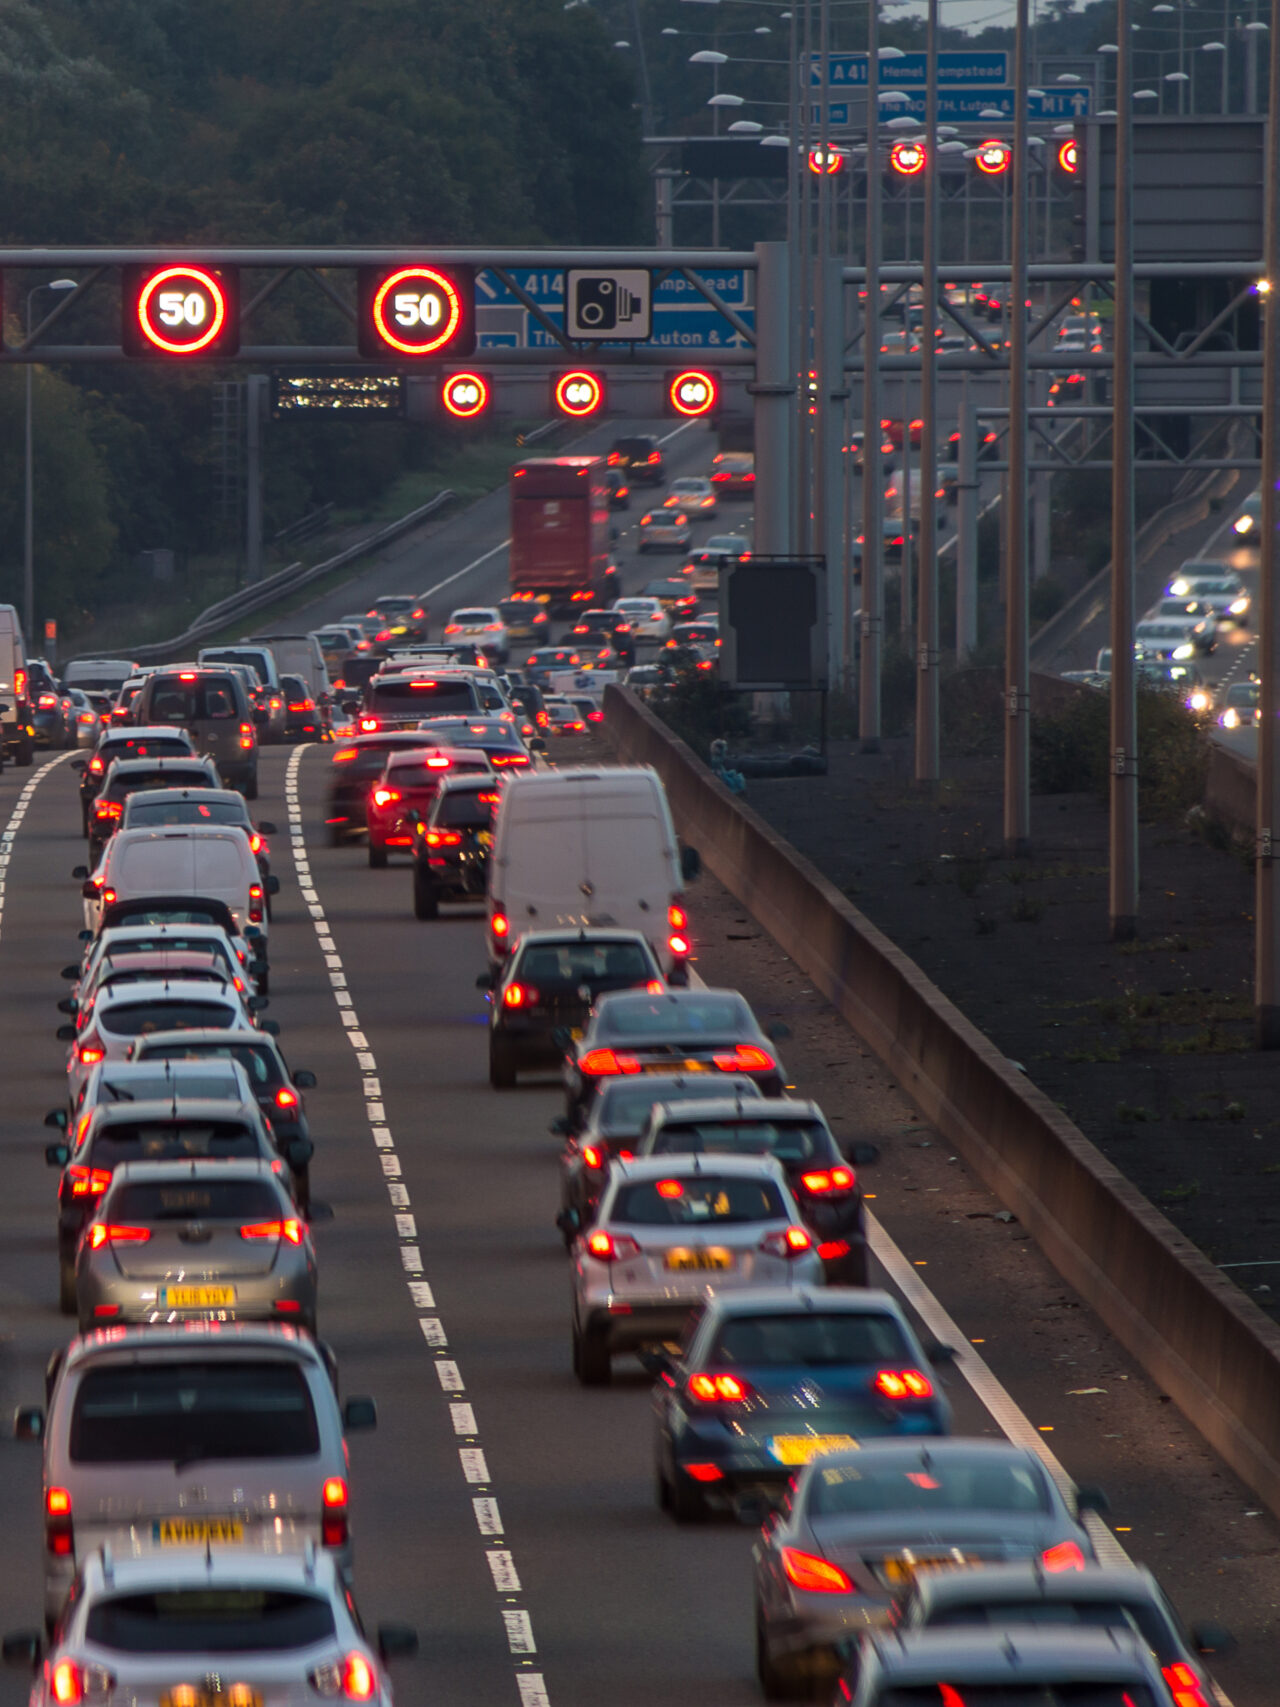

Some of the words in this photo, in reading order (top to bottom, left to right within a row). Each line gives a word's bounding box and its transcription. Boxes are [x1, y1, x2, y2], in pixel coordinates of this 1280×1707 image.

[882, 65, 925, 78] Hemel
[937, 64, 1003, 79] empstead
[158, 292, 206, 326] 50
[394, 293, 442, 327] 50
[707, 329, 721, 345] &
[452, 384, 479, 404] 60
[565, 383, 593, 403] 60
[679, 383, 707, 403] 60
